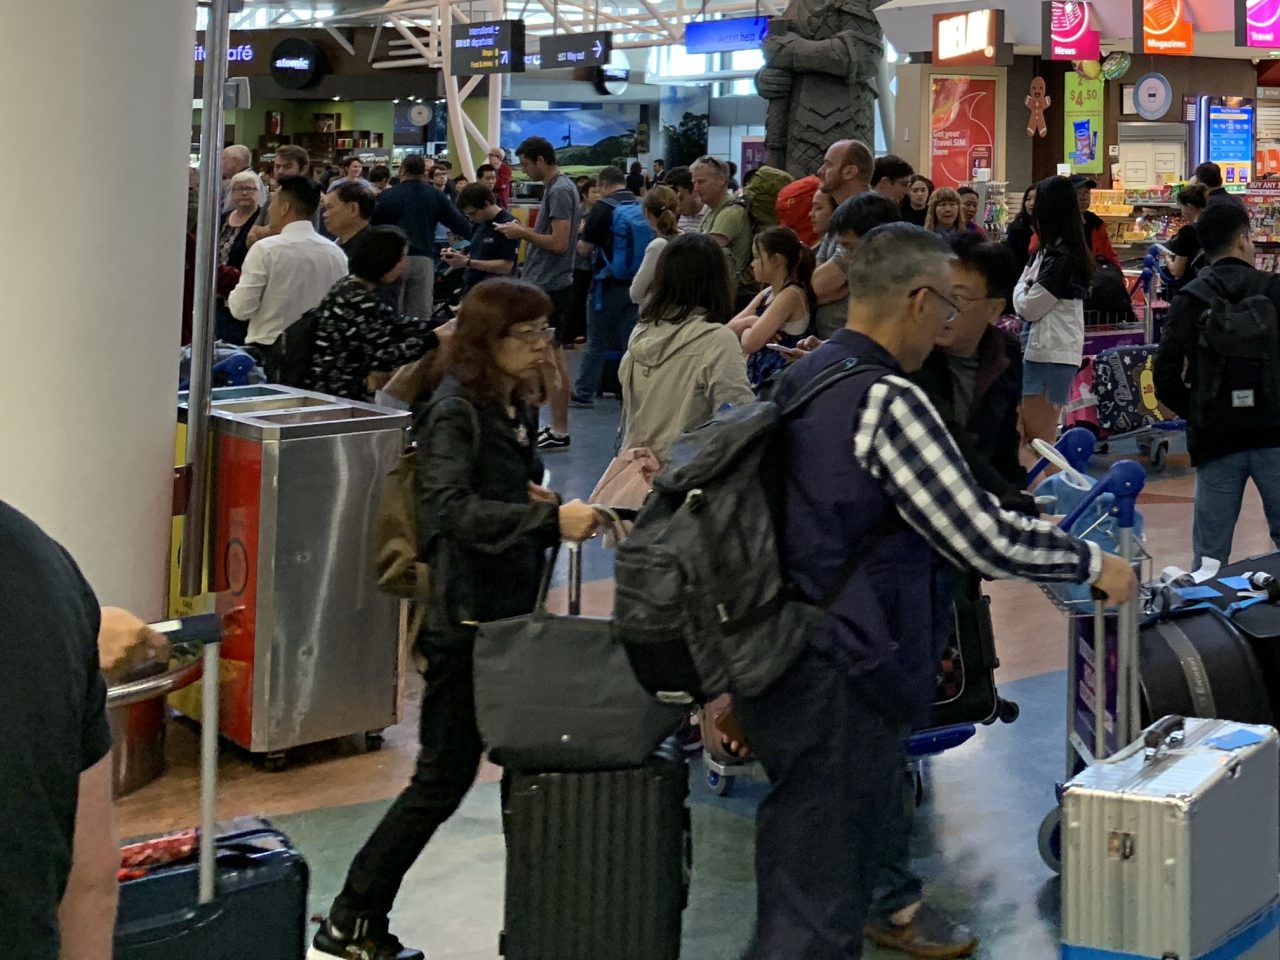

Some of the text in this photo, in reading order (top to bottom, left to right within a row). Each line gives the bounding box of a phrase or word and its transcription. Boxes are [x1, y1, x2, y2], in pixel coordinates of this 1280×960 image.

[1251, 31, 1275, 41] Travel
[1147, 39, 1187, 49] Magazines
[227, 45, 254, 61] afé
[1054, 46, 1076, 55] News
[275, 58, 310, 68] atomic
[1070, 89, 1098, 107] $4.50
[945, 131, 961, 140] your
[933, 148, 949, 156] here
